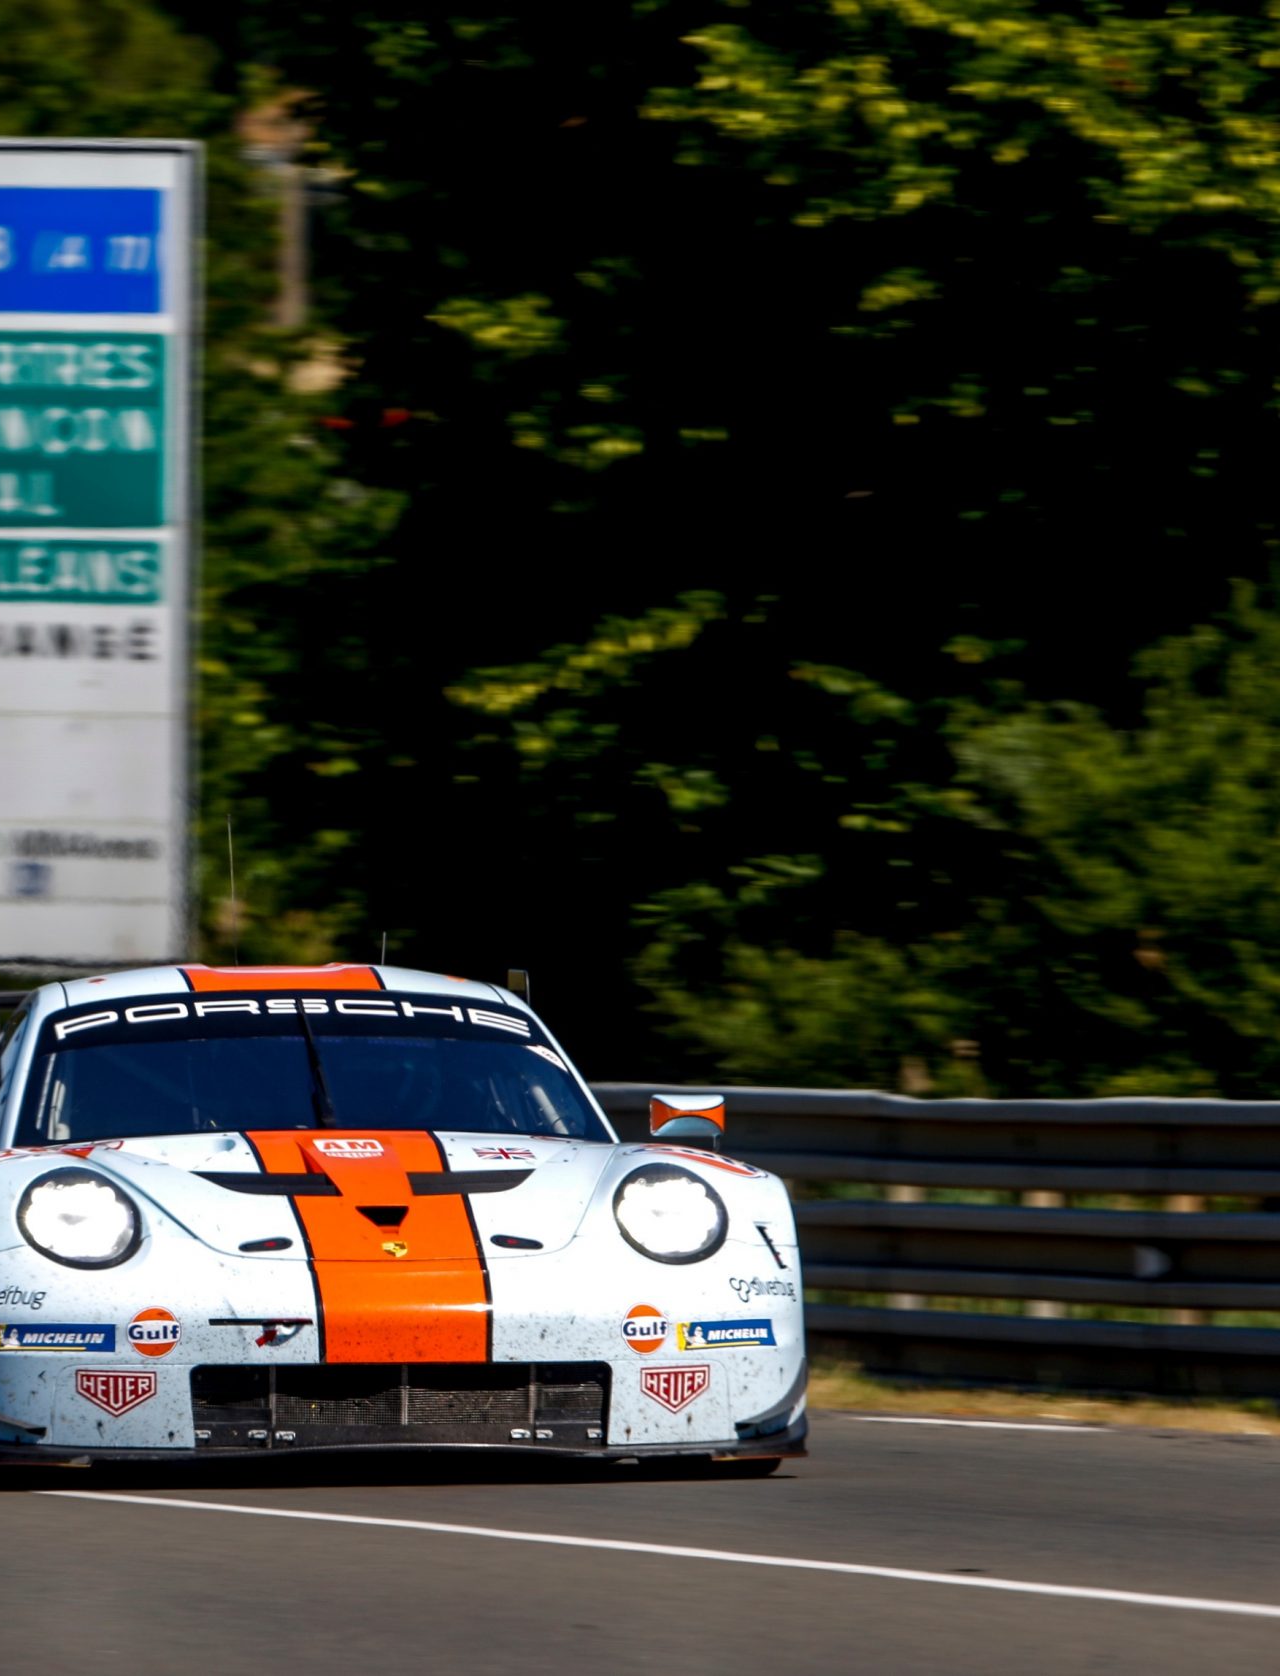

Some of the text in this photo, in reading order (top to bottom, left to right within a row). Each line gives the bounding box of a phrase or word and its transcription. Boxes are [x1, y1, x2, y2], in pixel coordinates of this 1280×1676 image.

[54, 998, 531, 1041] PORSCHE
[23, 1332, 105, 1344] MICHELIN
[128, 1324, 180, 1340] Gulf
[622, 1320, 668, 1338] Gulf
[706, 1328, 769, 1342] MICHELIN
[82, 1376, 150, 1409] HEUER
[645, 1372, 705, 1405] HEUER
